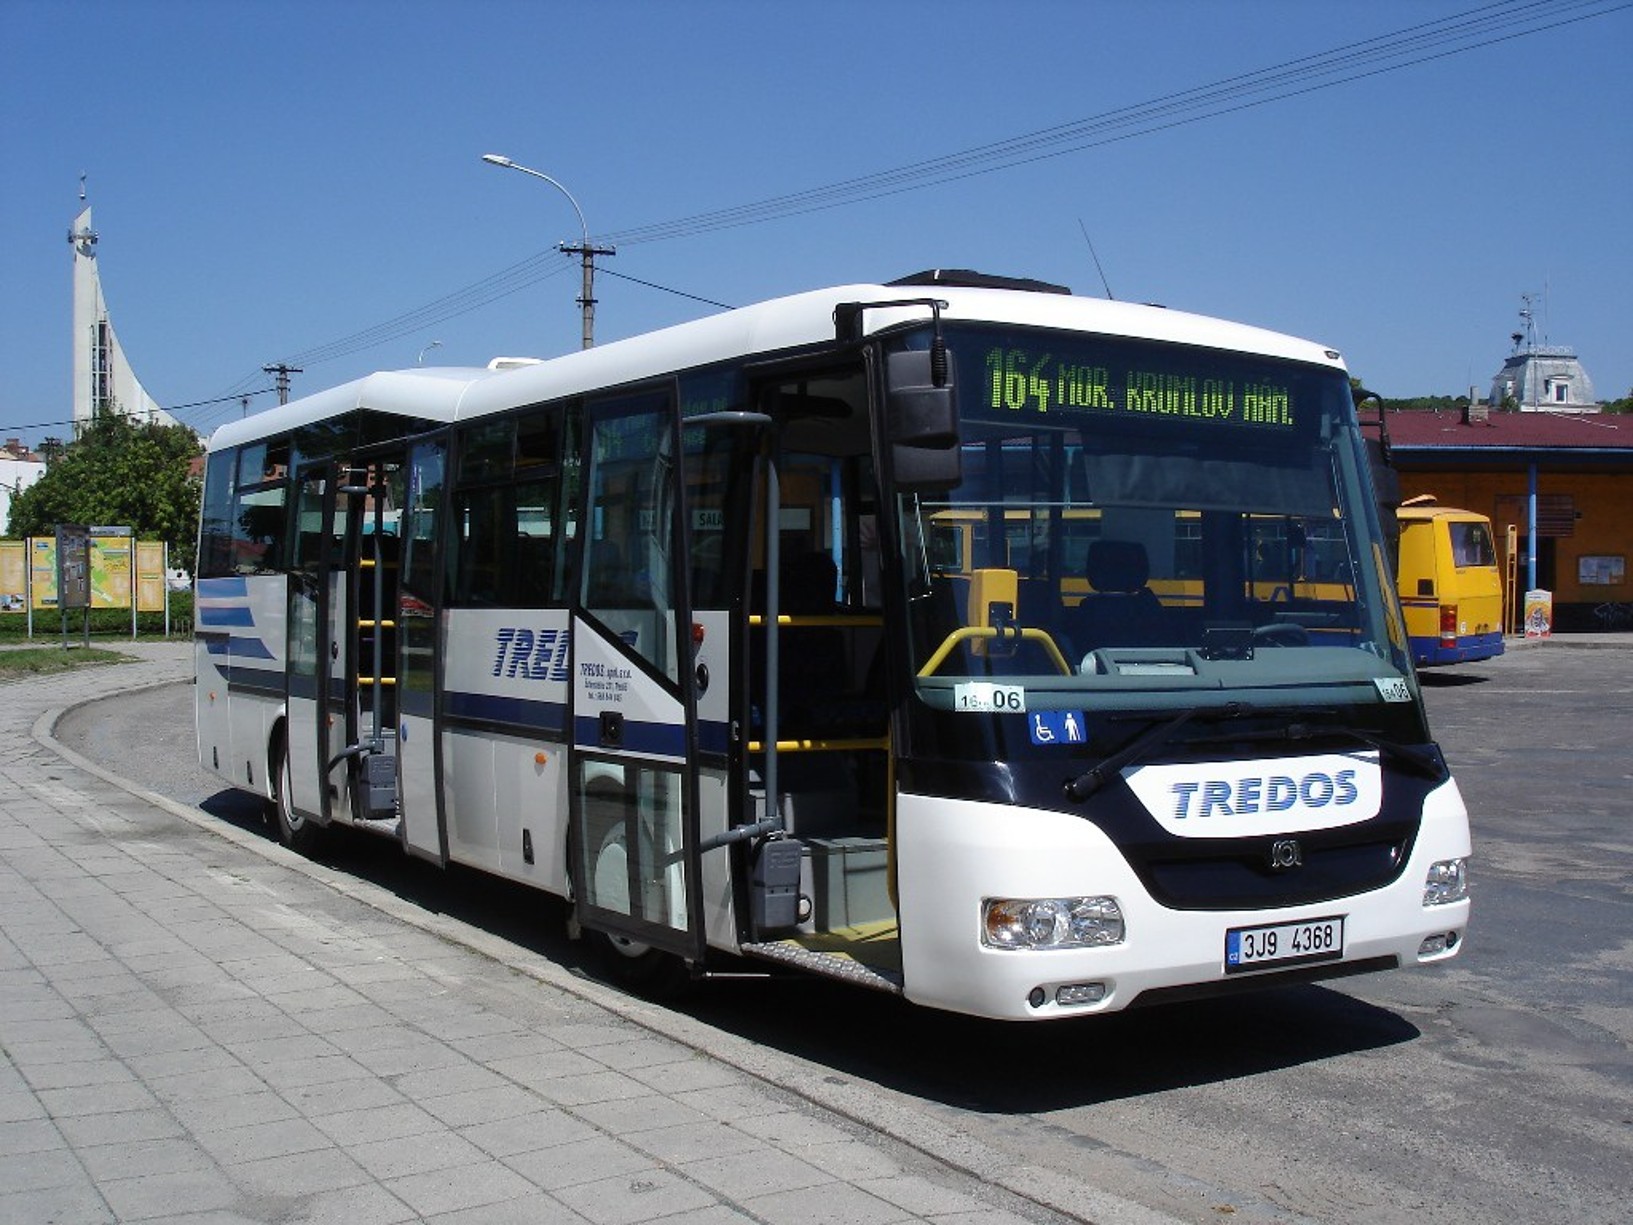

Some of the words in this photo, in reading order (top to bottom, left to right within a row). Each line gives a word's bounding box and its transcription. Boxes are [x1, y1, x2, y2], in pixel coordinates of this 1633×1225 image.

[986, 347, 1050, 413] 164
[1126, 371, 1234, 418] KRUMLOV
[993, 690, 1021, 710] 06
[1170, 769, 1359, 819] TREDOS
[1244, 931, 1278, 959] 3J9
[1291, 924, 1333, 953] 4368
